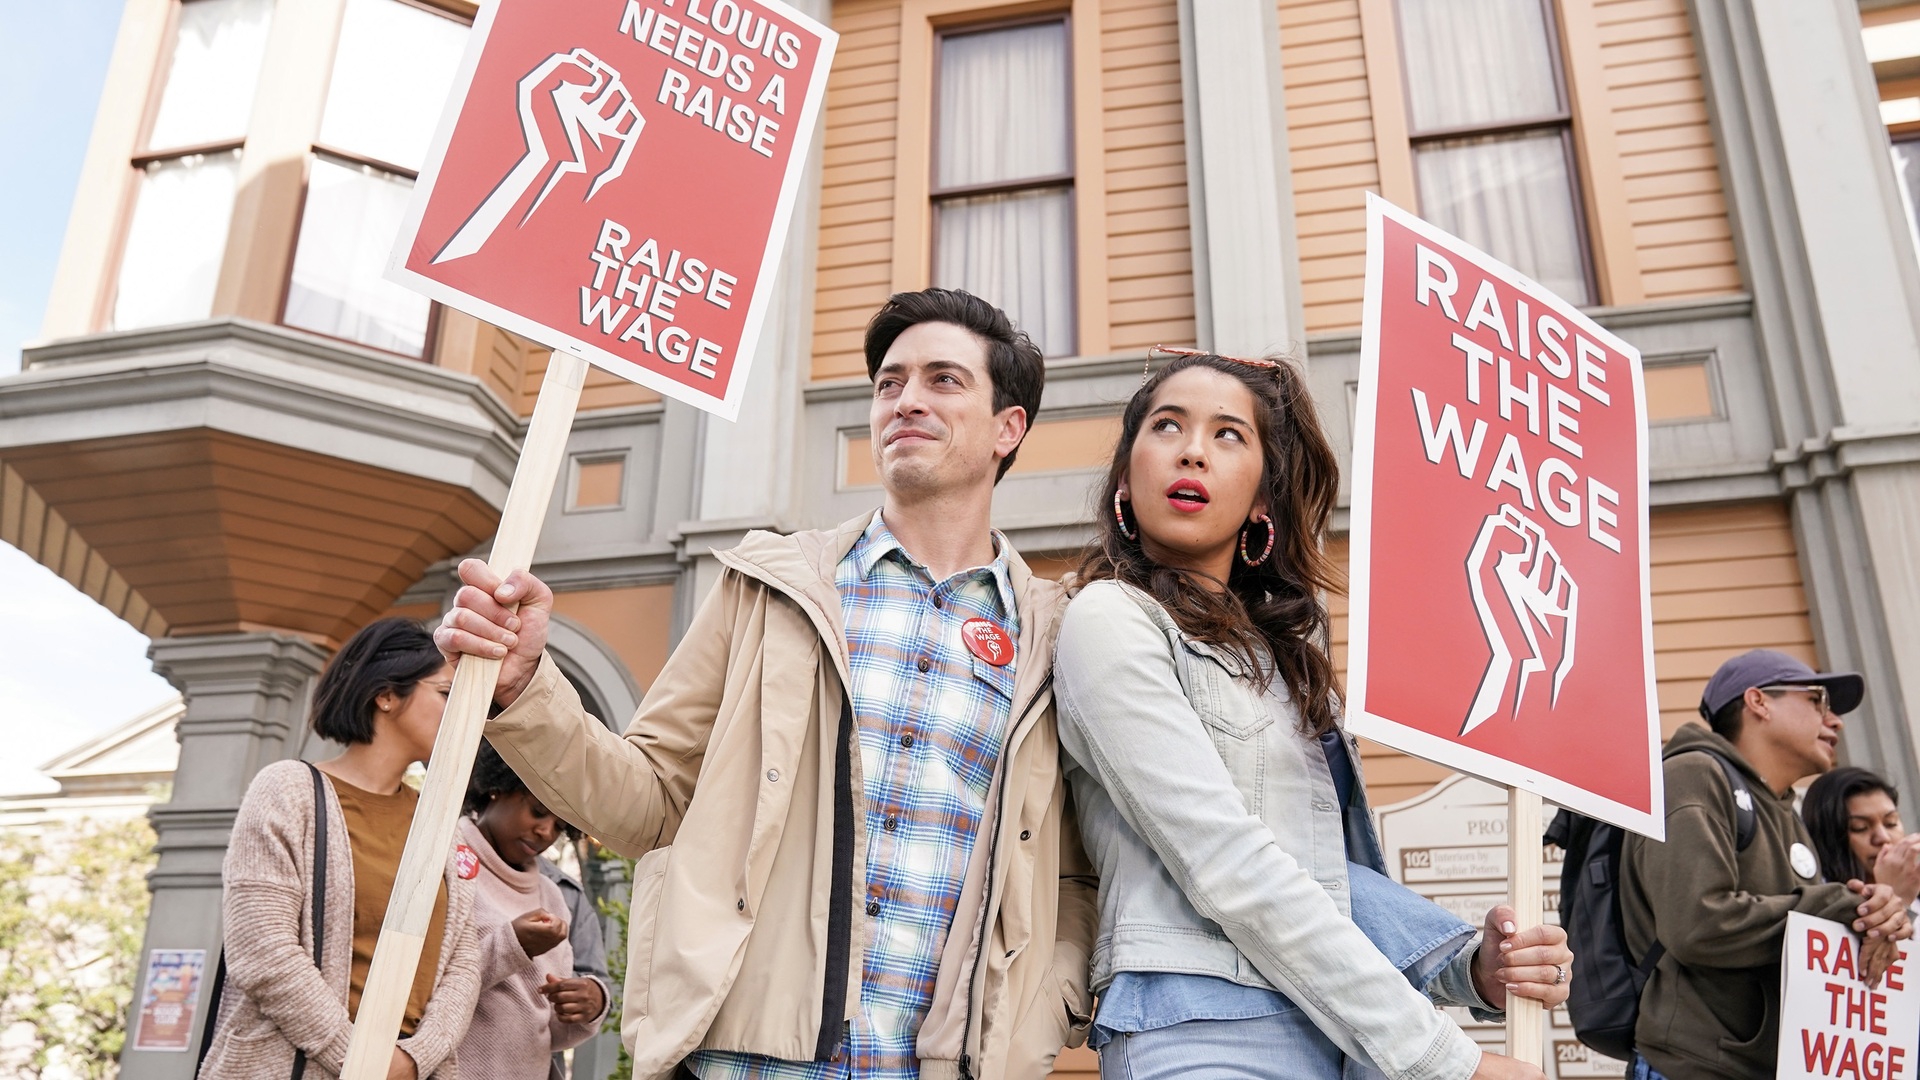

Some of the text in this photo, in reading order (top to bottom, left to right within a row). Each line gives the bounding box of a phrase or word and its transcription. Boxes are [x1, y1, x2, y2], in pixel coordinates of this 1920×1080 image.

[617, 0, 786, 115] NEEDS A
[685, 0, 802, 70] LOUIS
[657, 68, 780, 158] RAISE
[590, 251, 682, 322] THE
[596, 218, 738, 310] RAISE
[578, 286, 723, 379] WAGE
[1415, 243, 1611, 406] RAISE
[1451, 332, 1583, 459] THE
[1410, 387, 1621, 554] WAGE
[976, 633, 1001, 641] WAGE
[1403, 851, 1429, 868] 102
[1807, 928, 1908, 991] RAE
[1824, 982, 1887, 1036] THE
[1557, 1044, 1586, 1061] 204
[1801, 1029, 1906, 1080] WAGE
